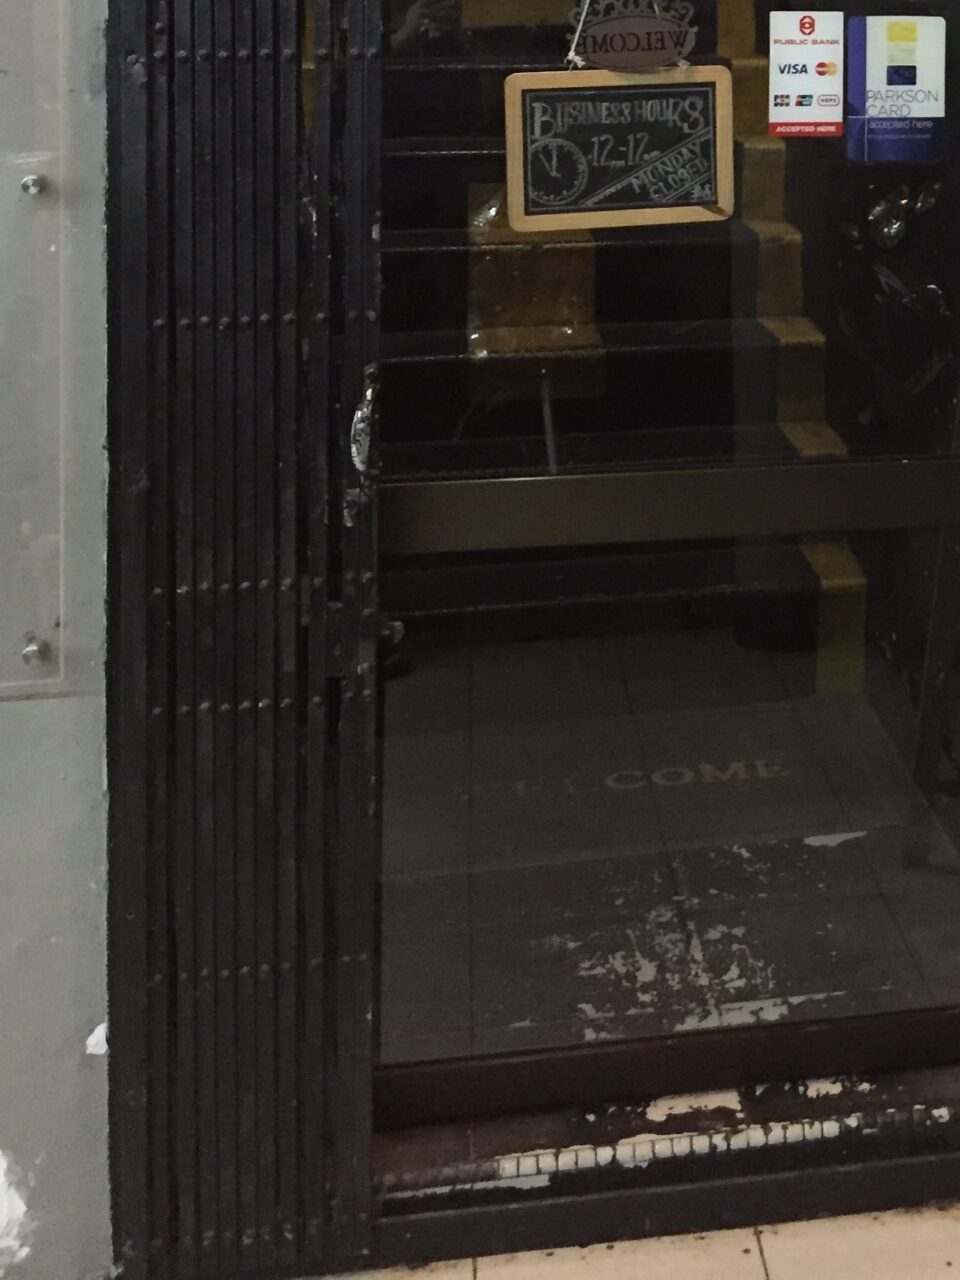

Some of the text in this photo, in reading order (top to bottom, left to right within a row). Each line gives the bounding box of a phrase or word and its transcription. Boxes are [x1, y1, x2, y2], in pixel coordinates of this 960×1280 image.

[778, 63, 808, 75] VISA
[866, 89, 939, 103] PARKSON
[866, 104, 912, 118] CARD
